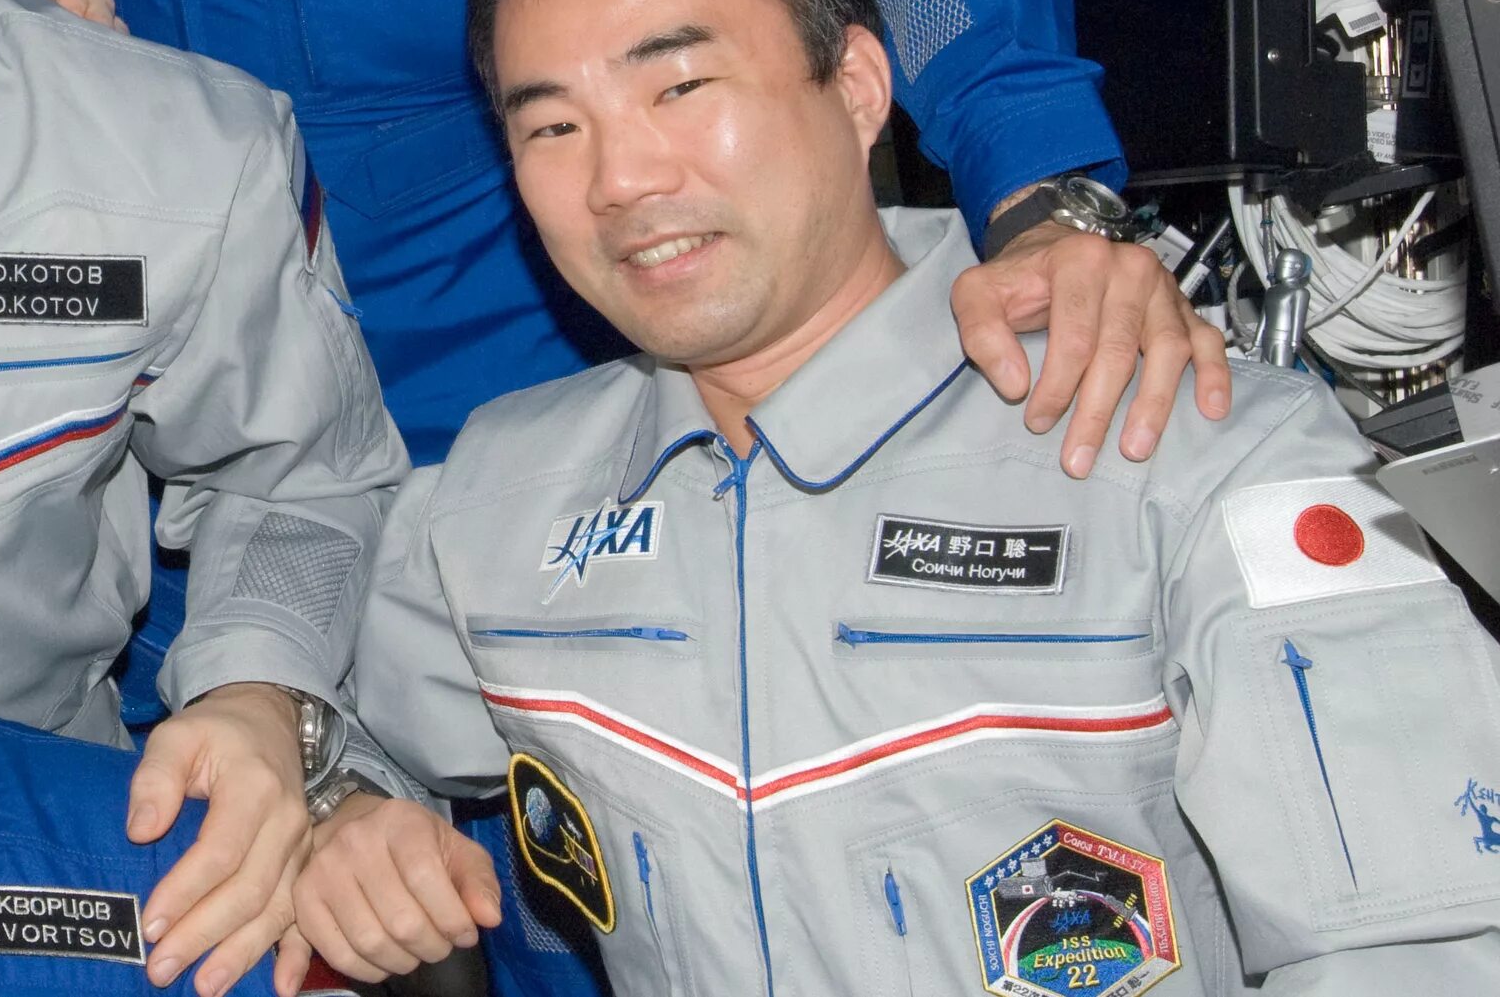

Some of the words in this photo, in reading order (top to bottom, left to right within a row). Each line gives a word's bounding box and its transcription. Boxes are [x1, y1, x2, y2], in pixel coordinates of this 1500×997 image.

[547, 504, 656, 586] JAXA
[911, 558, 964, 577] Соичи
[968, 564, 1025, 582] Ногучи
[975, 894, 995, 936] NOGUCHI
[985, 936, 1000, 971] SOICHI
[1062, 935, 1091, 950] ISS
[1033, 945, 1127, 969] Expedition
[1067, 964, 1100, 989] 22
